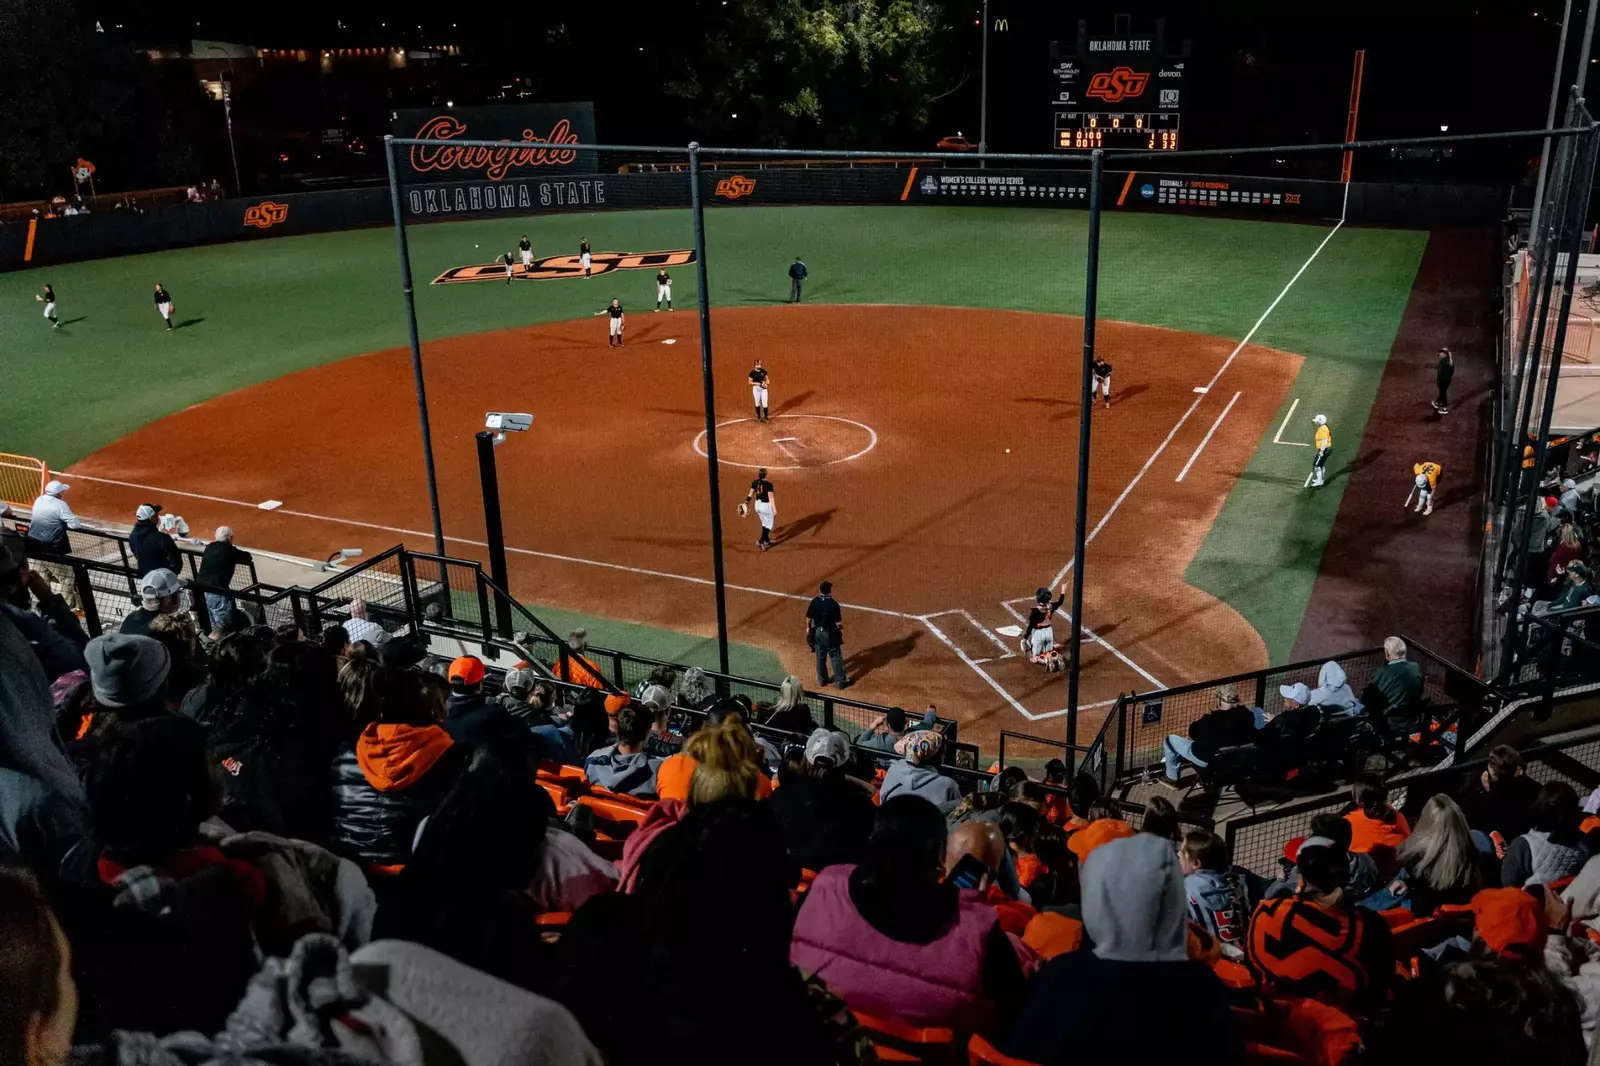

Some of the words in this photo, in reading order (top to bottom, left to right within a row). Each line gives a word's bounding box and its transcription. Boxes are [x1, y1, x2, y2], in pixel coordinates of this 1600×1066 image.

[1089, 41, 1127, 51] OKLAHOMA
[1129, 40, 1151, 51] STATE
[1158, 69, 1181, 78] devon
[1086, 66, 1150, 103] OSU
[1163, 91, 1177, 103] IQ
[1090, 118, 1096, 128] 0
[1113, 118, 1119, 128] 0
[1136, 118, 1142, 128] 0
[410, 115, 579, 181] Cowgirls
[1149, 140, 1154, 149] 2
[1162, 140, 1168, 149] 3
[1170, 141, 1175, 149] 2
[940, 175, 965, 184] WOMEN'S
[965, 176, 987, 184] COLLEGE
[987, 176, 1005, 185] WORLD
[1006, 177, 1024, 185] SERIES
[1160, 179, 1183, 187] REGIONALS
[715, 175, 757, 199] OSU
[410, 184, 531, 214] OKLAHOMA
[540, 180, 605, 206] STATE
[244, 201, 288, 229] OSU
[429, 248, 697, 286] OSU
